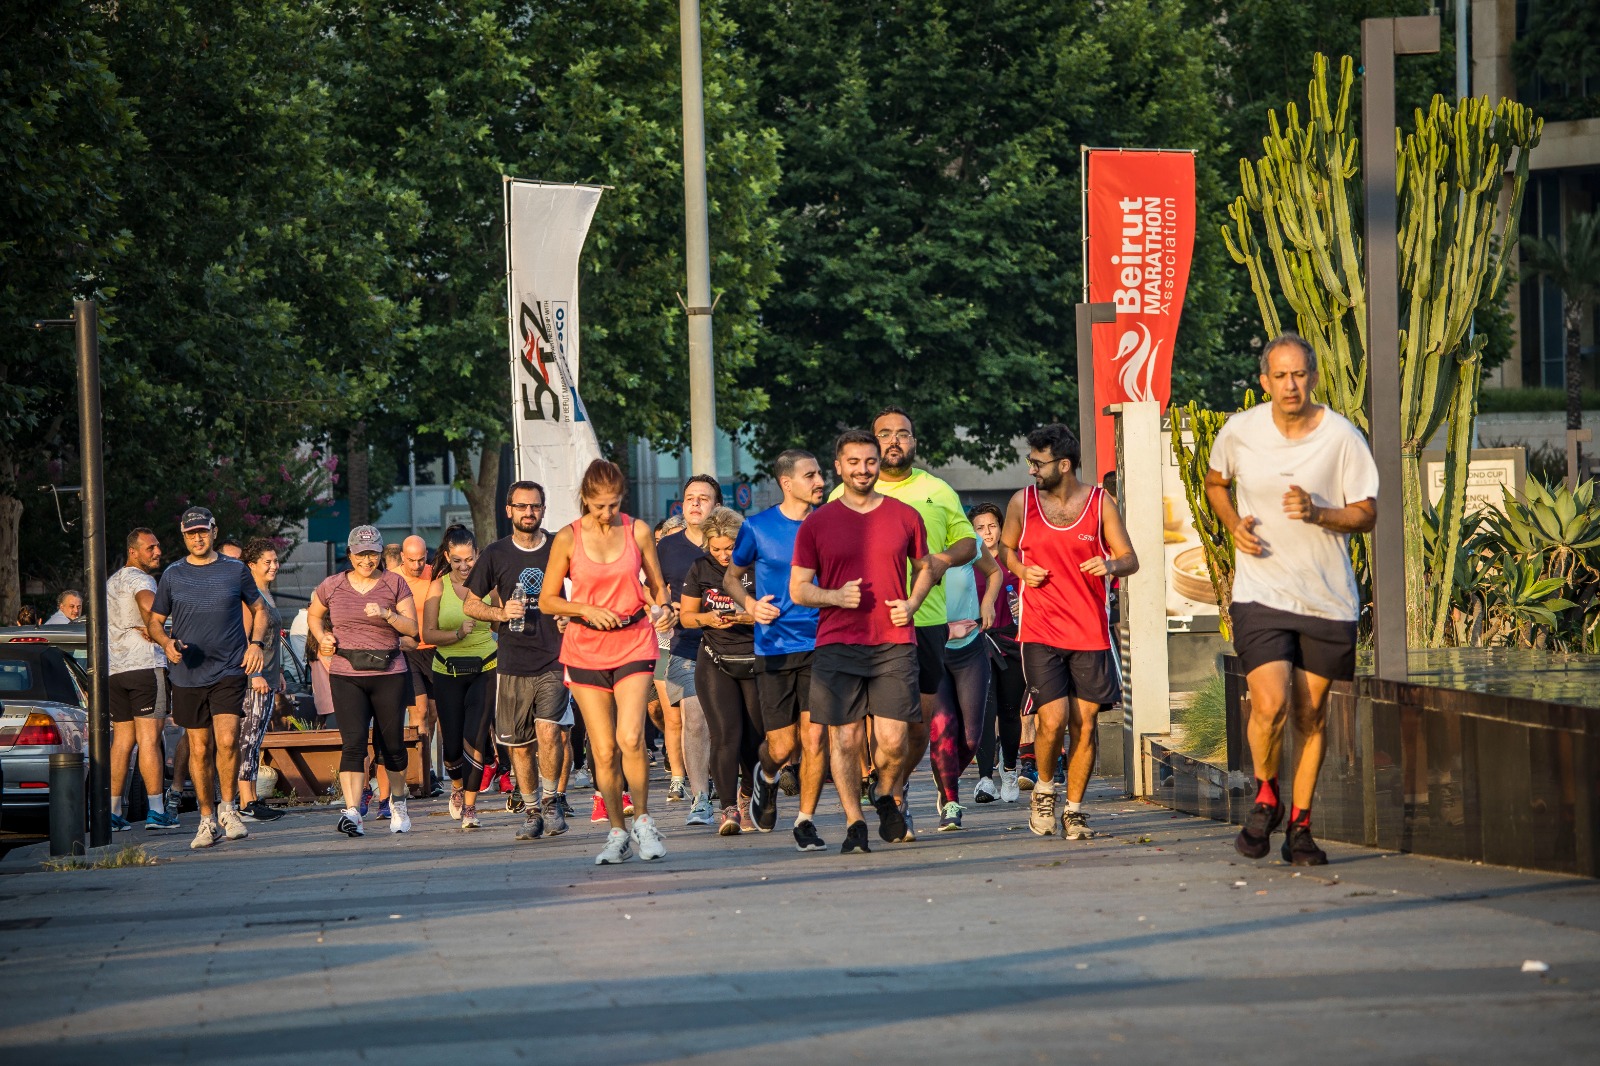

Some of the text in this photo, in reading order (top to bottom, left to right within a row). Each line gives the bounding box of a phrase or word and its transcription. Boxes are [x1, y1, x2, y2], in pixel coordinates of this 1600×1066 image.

[1111, 196, 1144, 314] Beirut
[1143, 196, 1162, 315] MARATHON
[1161, 197, 1177, 316] Association
[562, 395, 570, 413] BEIRUT
